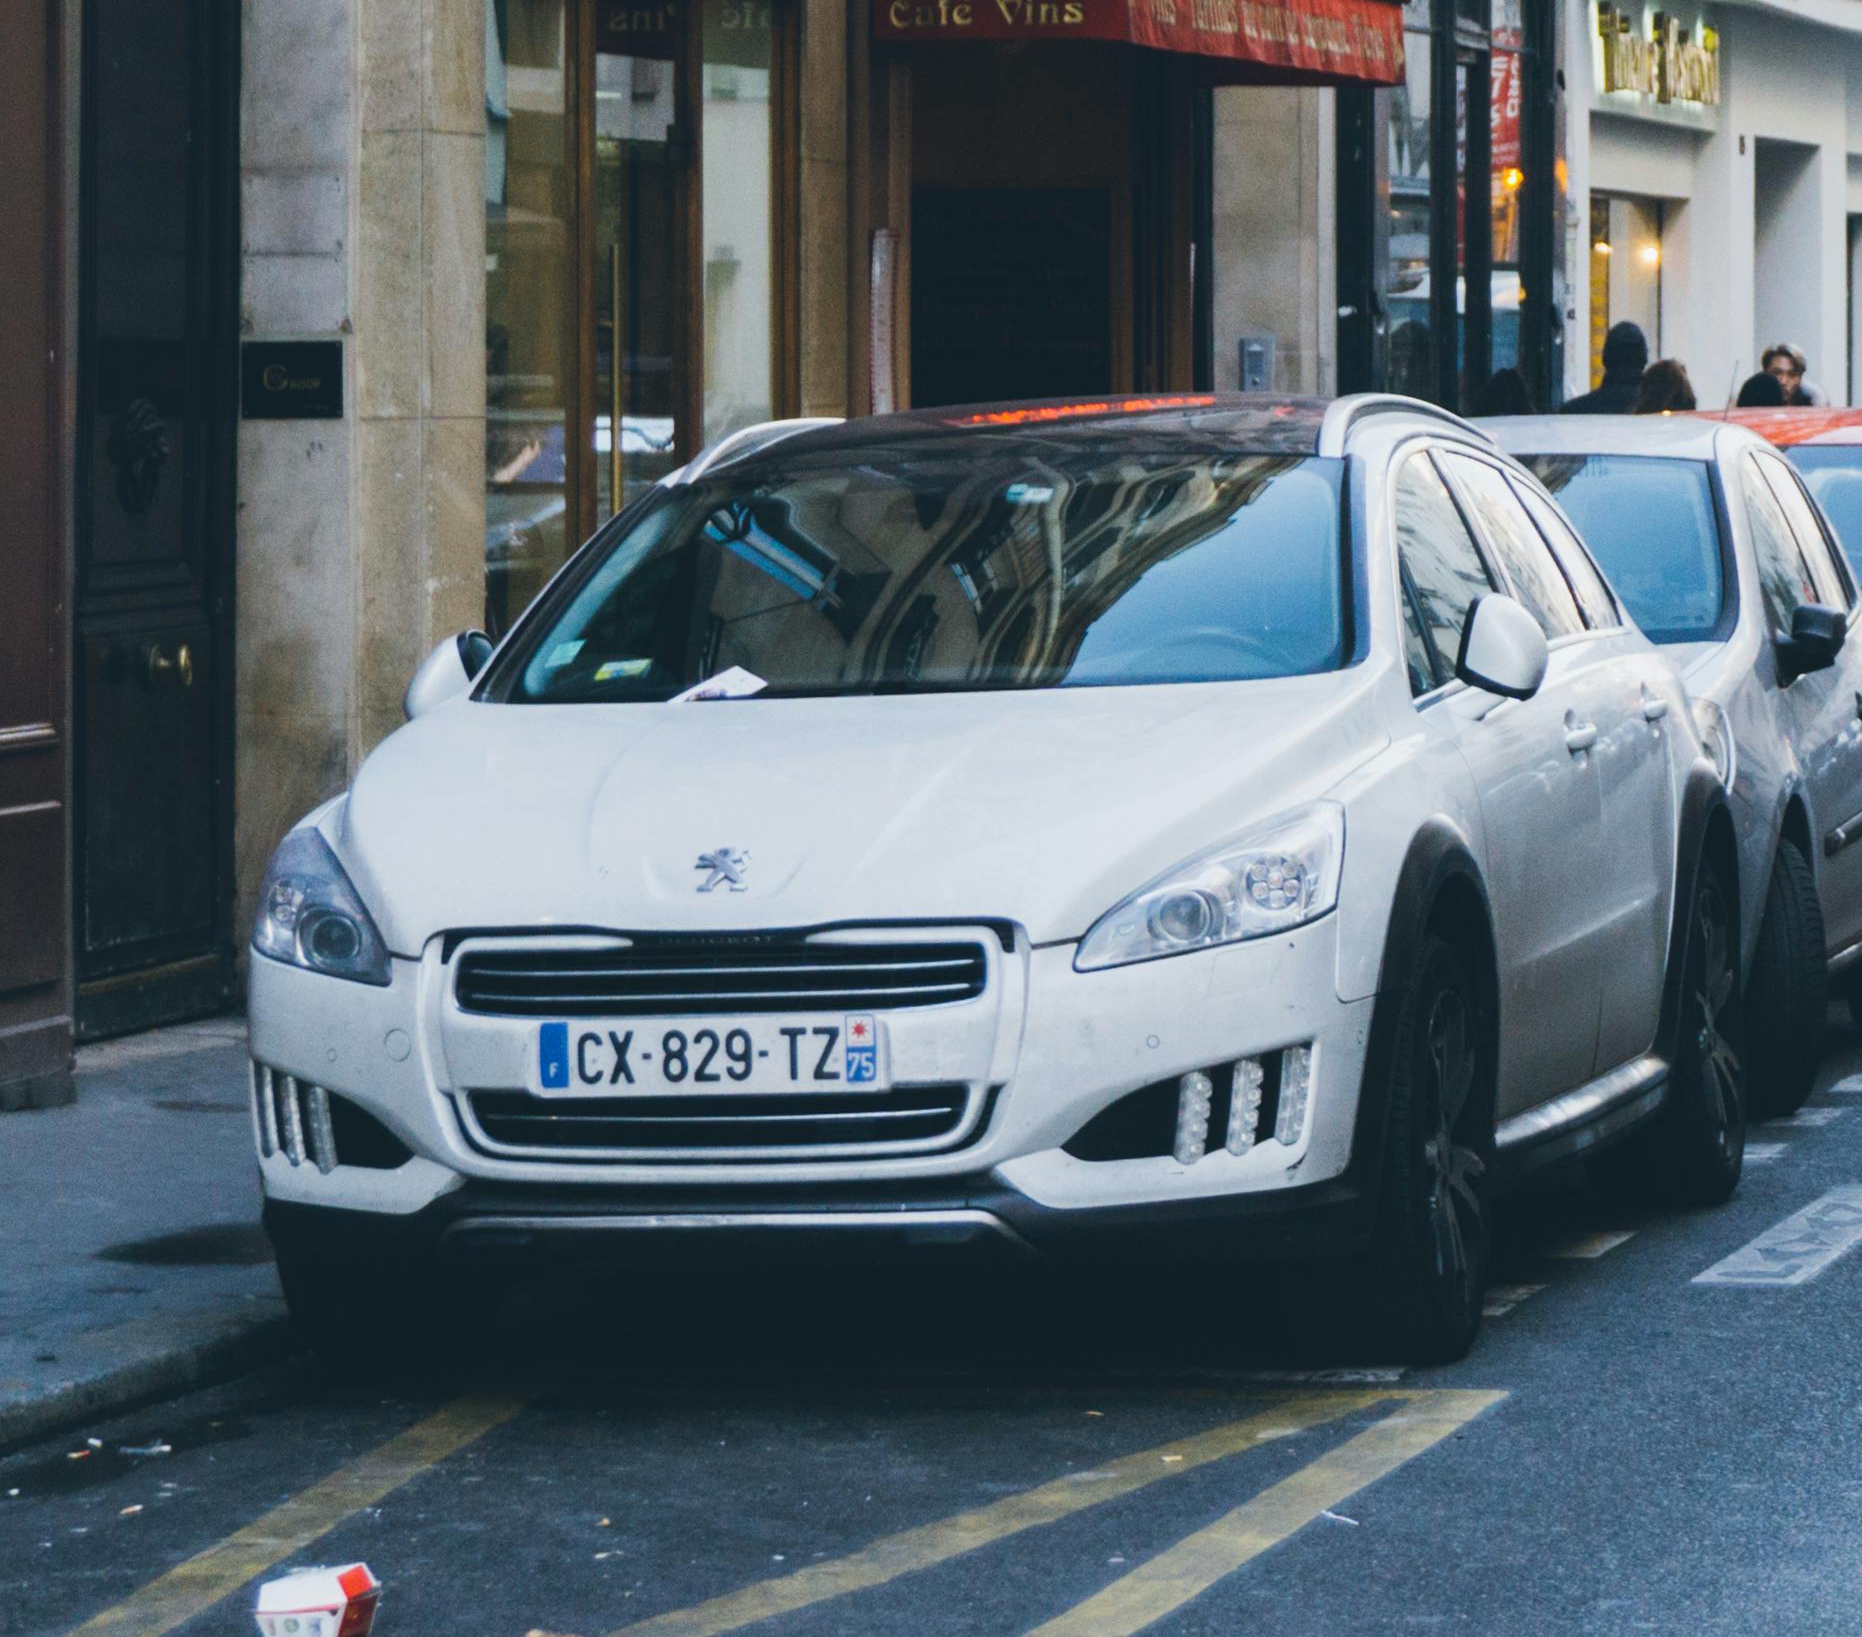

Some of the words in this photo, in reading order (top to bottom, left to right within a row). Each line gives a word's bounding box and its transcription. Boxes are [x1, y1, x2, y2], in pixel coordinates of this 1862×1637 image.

[548, 1061, 559, 1079] F
[576, 1027, 842, 1085] CX-829-TZ
[847, 1052, 875, 1081] 75
